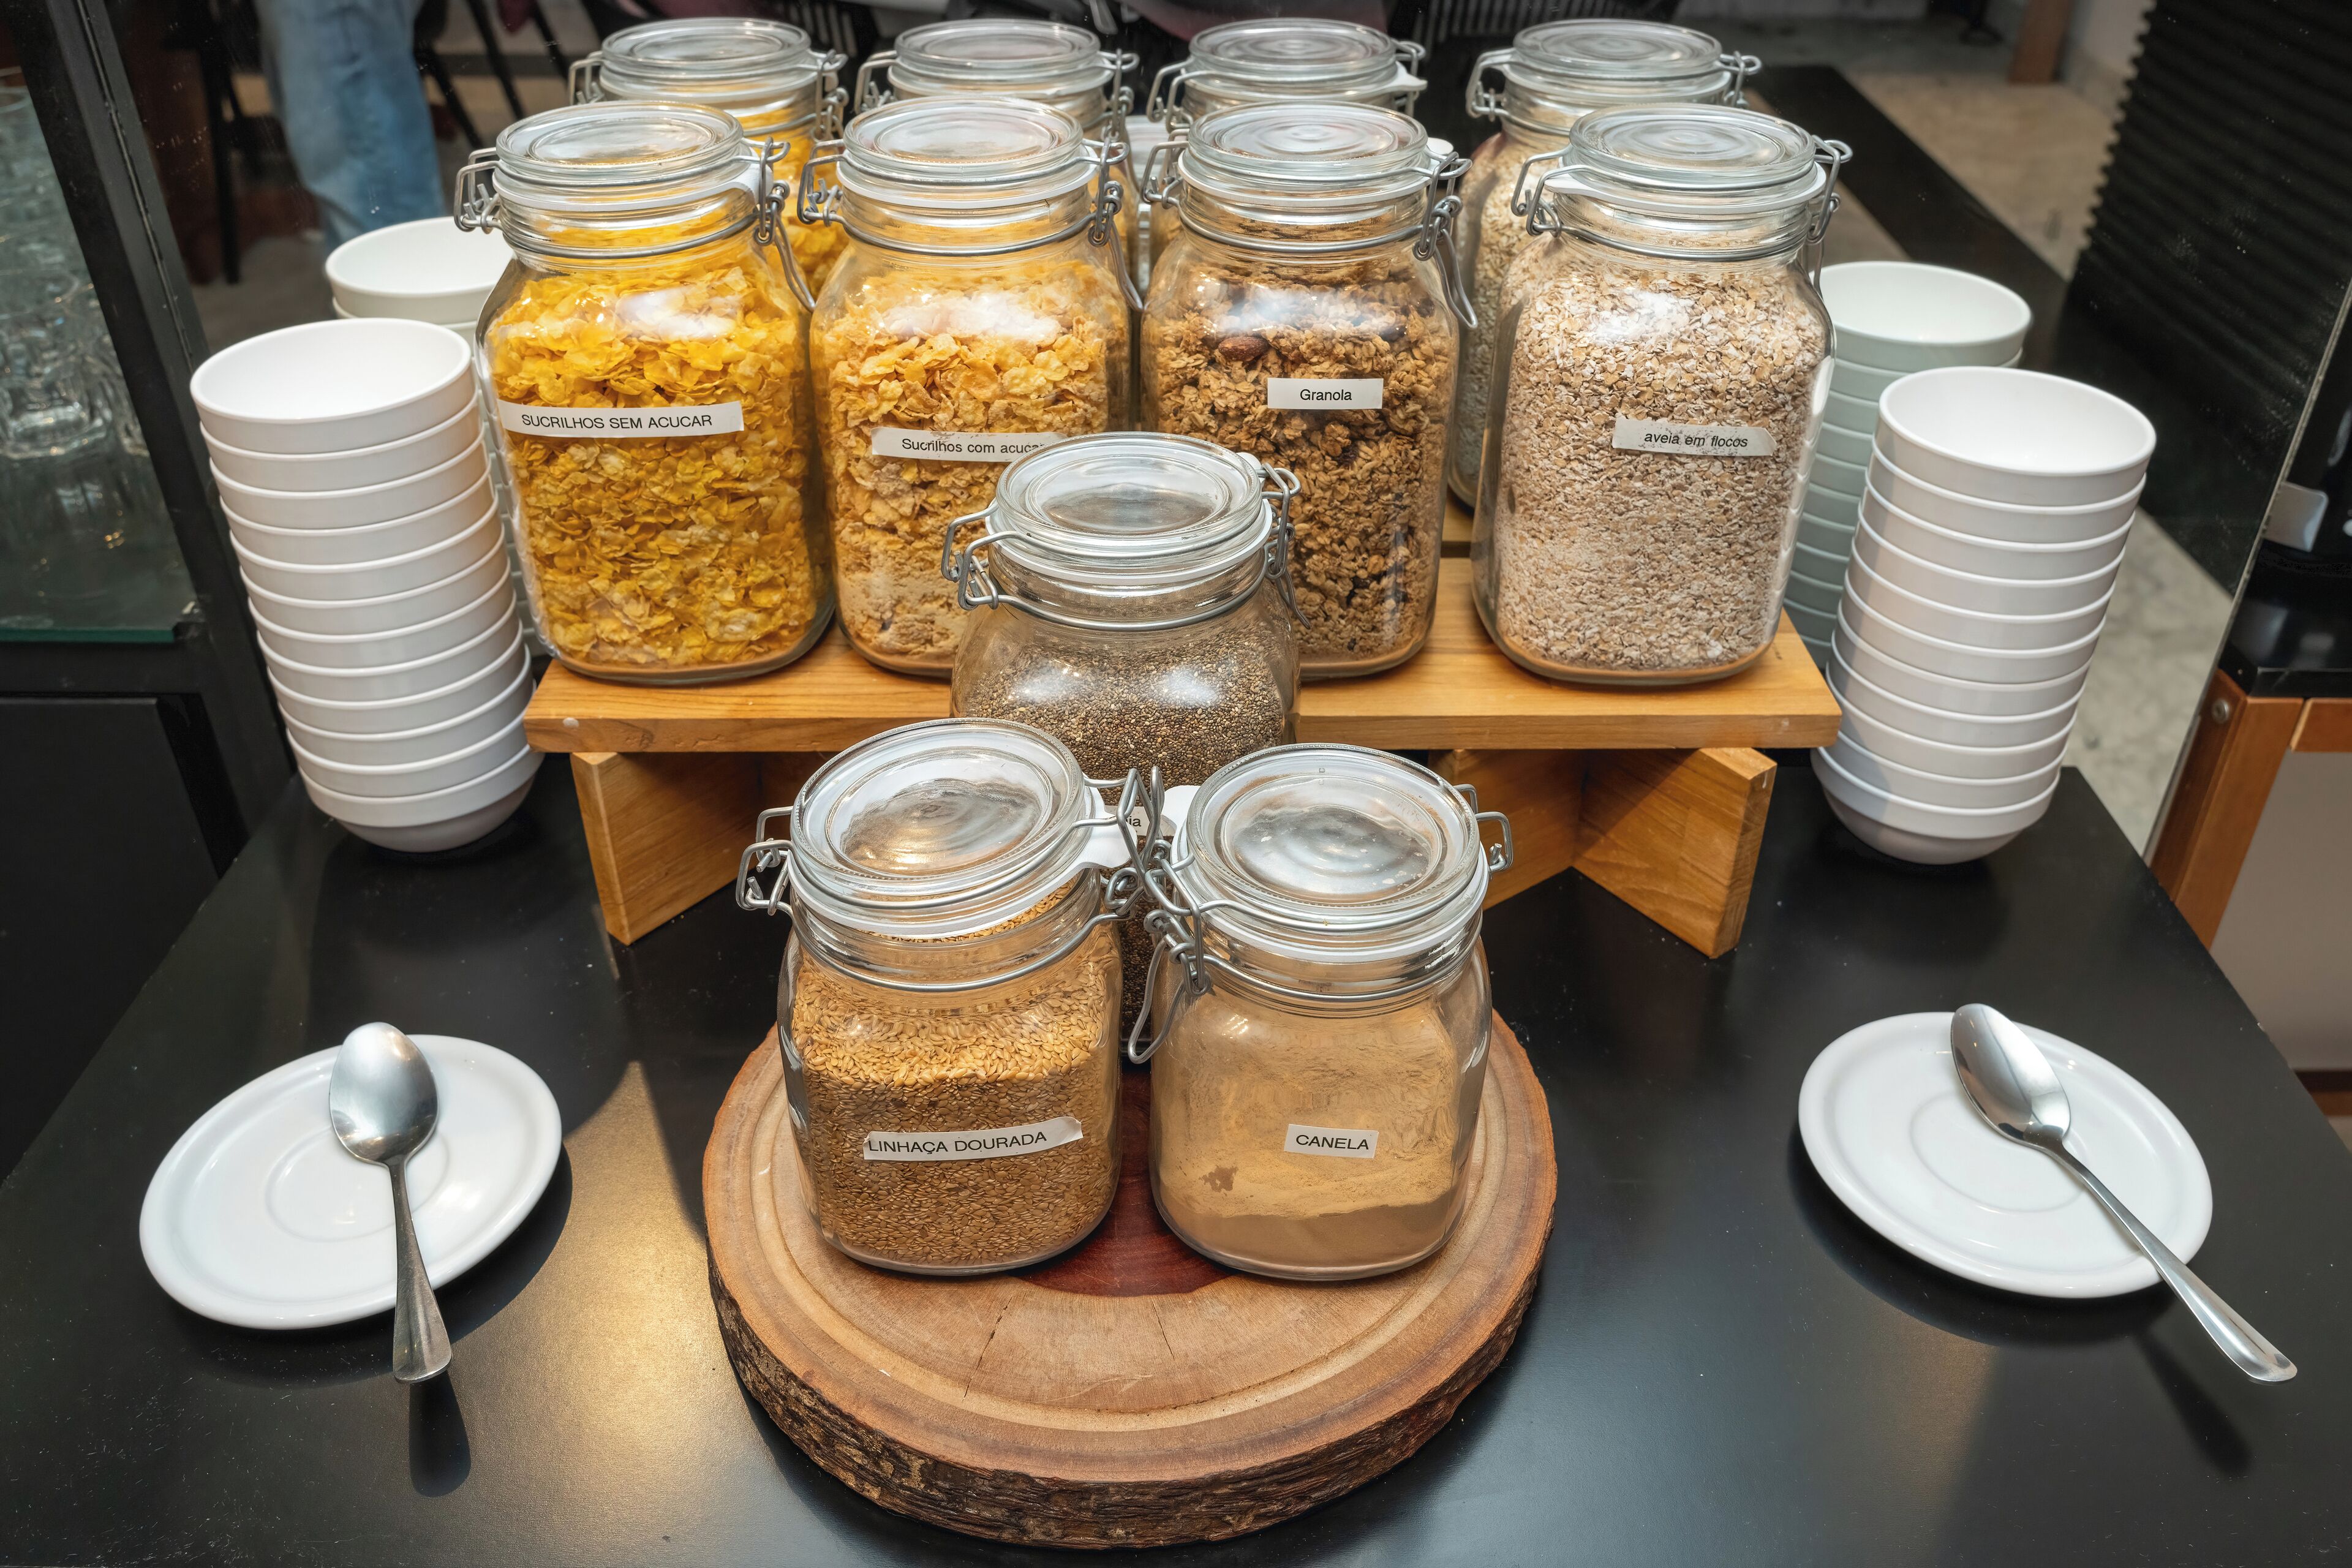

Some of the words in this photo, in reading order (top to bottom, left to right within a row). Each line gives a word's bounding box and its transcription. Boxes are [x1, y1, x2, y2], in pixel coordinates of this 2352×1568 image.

[1300, 388, 1352, 401] Granola
[521, 413, 605, 429] SUCRILHOS
[609, 417, 642, 429] SEM
[648, 414, 712, 429] ACUCAR
[902, 438, 962, 453] Sucrilhos
[967, 444, 995, 453] com
[1644, 432, 1679, 445] aveia
[1685, 436, 1705, 446] em
[1711, 435, 1748, 447] flocos
[868, 1140, 948, 1155] LINHAÇA
[954, 1131, 1047, 1152] DOURADA
[1295, 1134, 1369, 1150] CANELA
